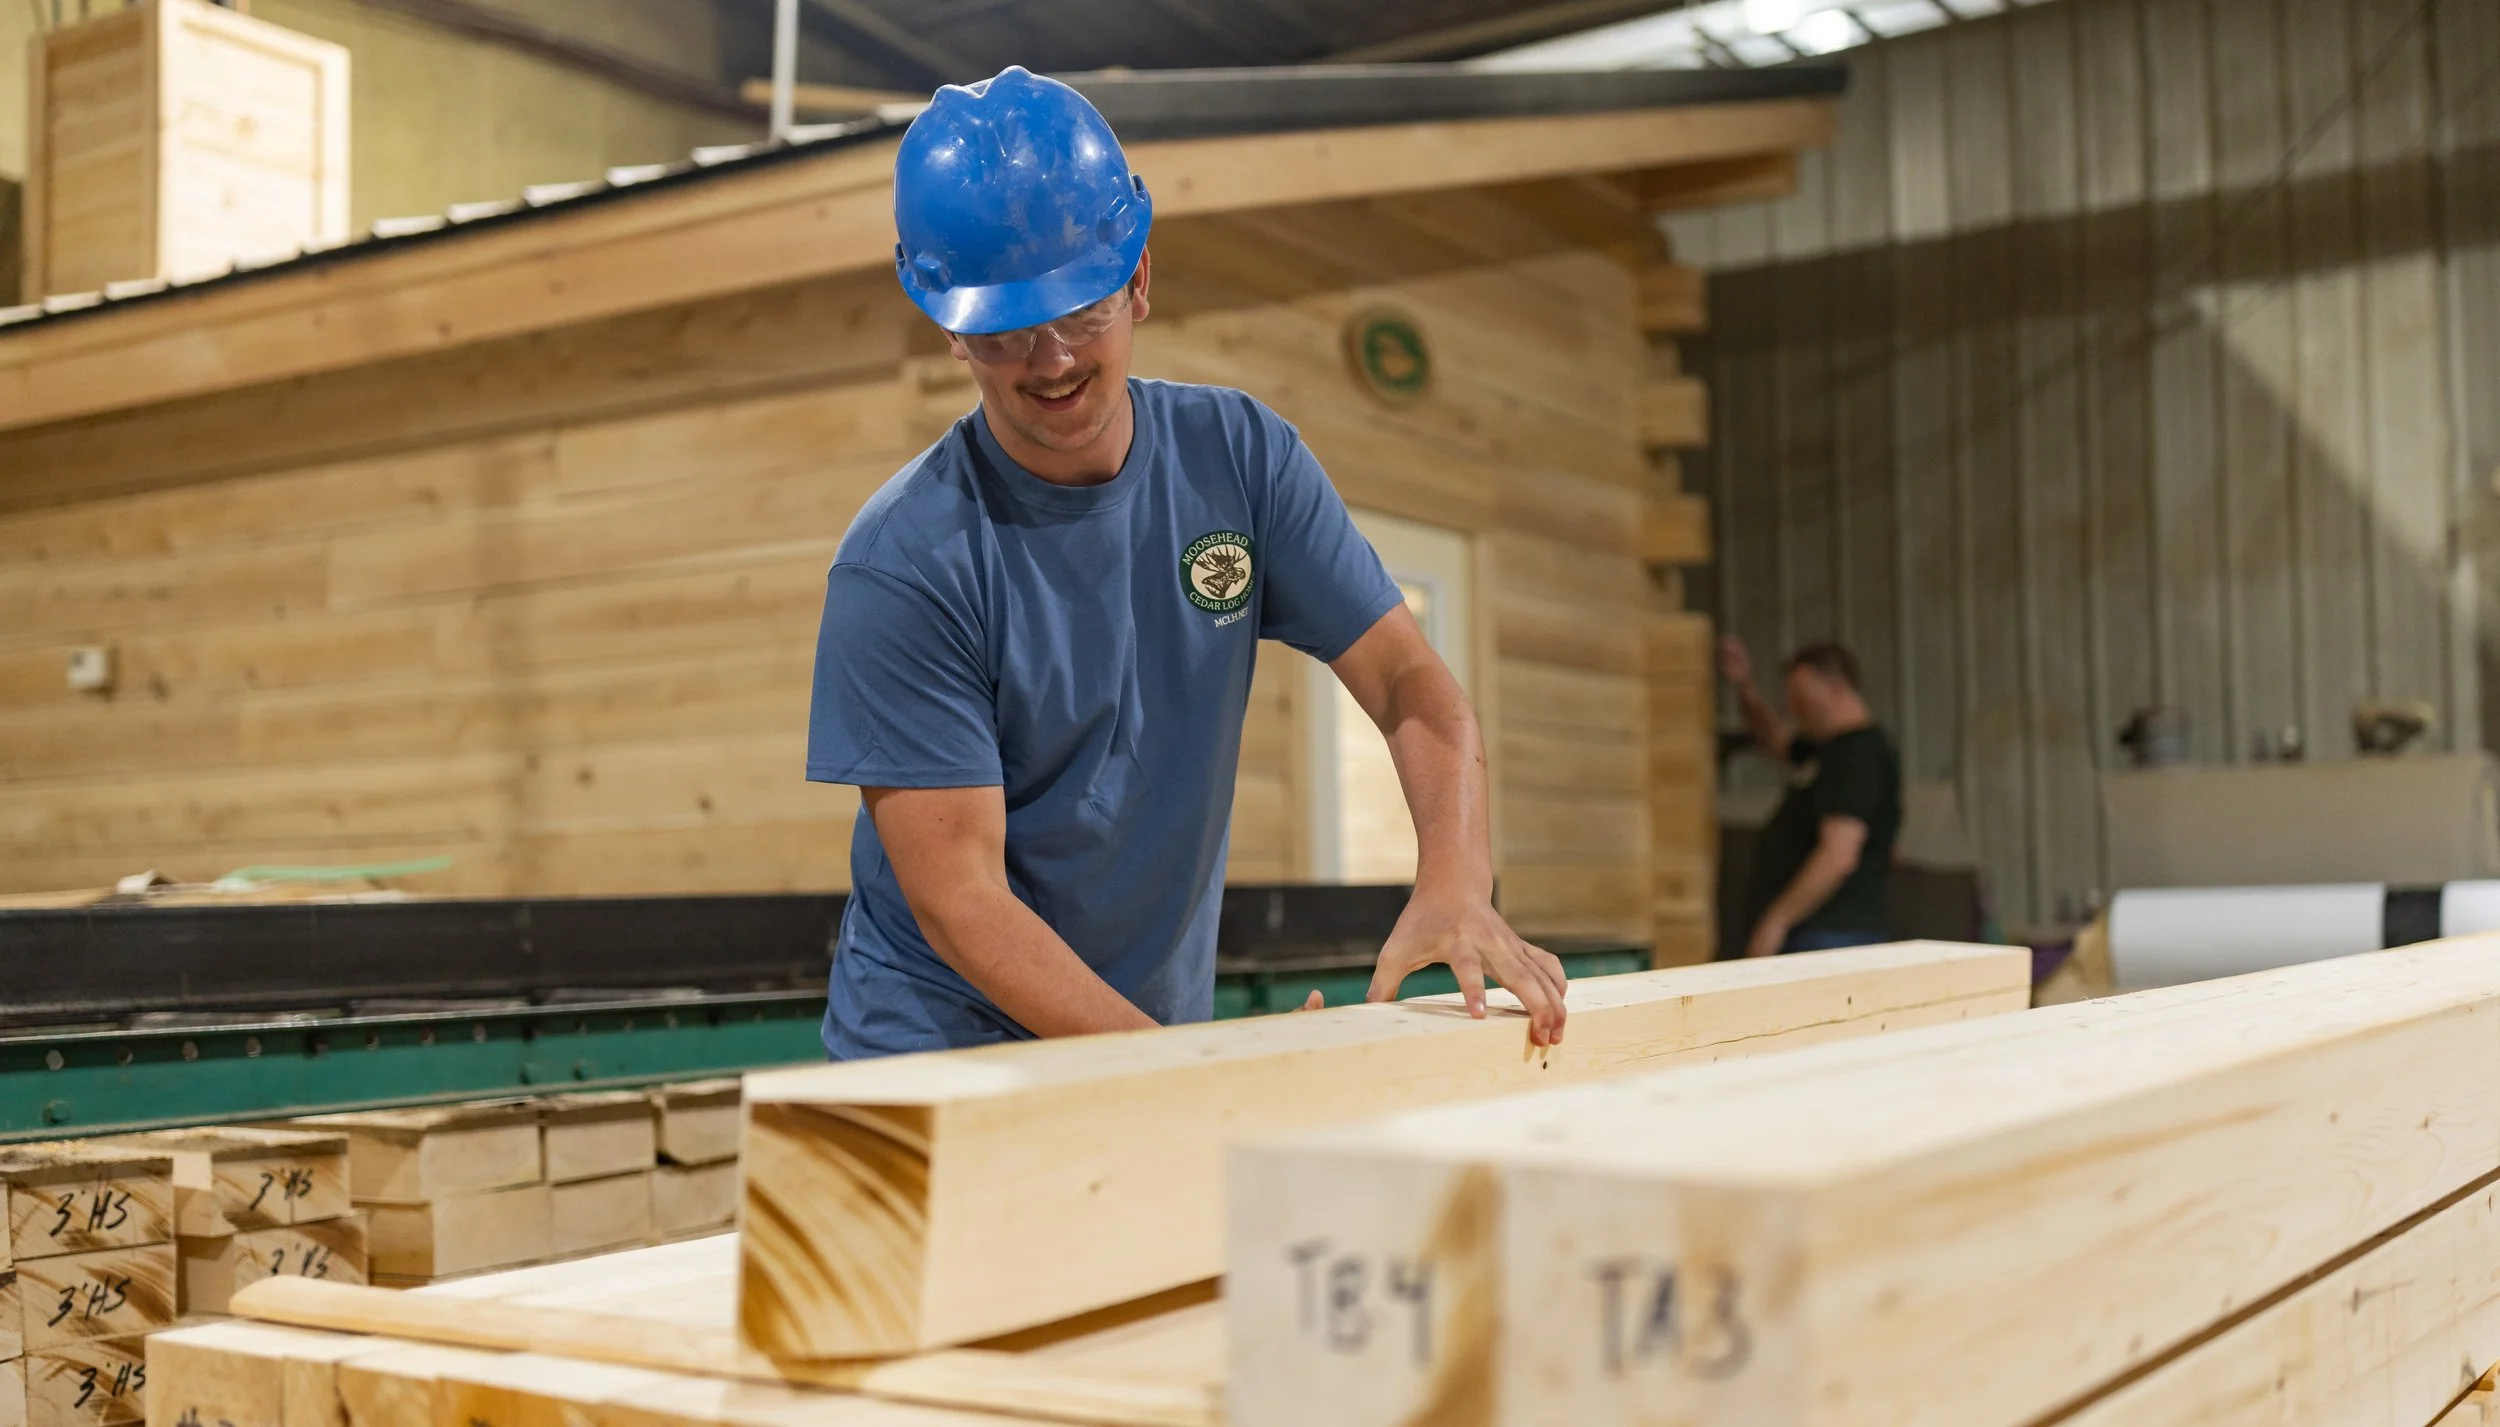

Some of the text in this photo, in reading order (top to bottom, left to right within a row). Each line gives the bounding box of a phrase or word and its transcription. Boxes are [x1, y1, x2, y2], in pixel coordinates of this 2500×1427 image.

[1182, 532, 1248, 565] MOOSEHEAD
[1189, 591, 1221, 610] CEDAR
[1222, 597, 1241, 610] LOG
[1284, 1237, 1433, 1372] TB4
[1586, 1254, 1754, 1383] TA3
